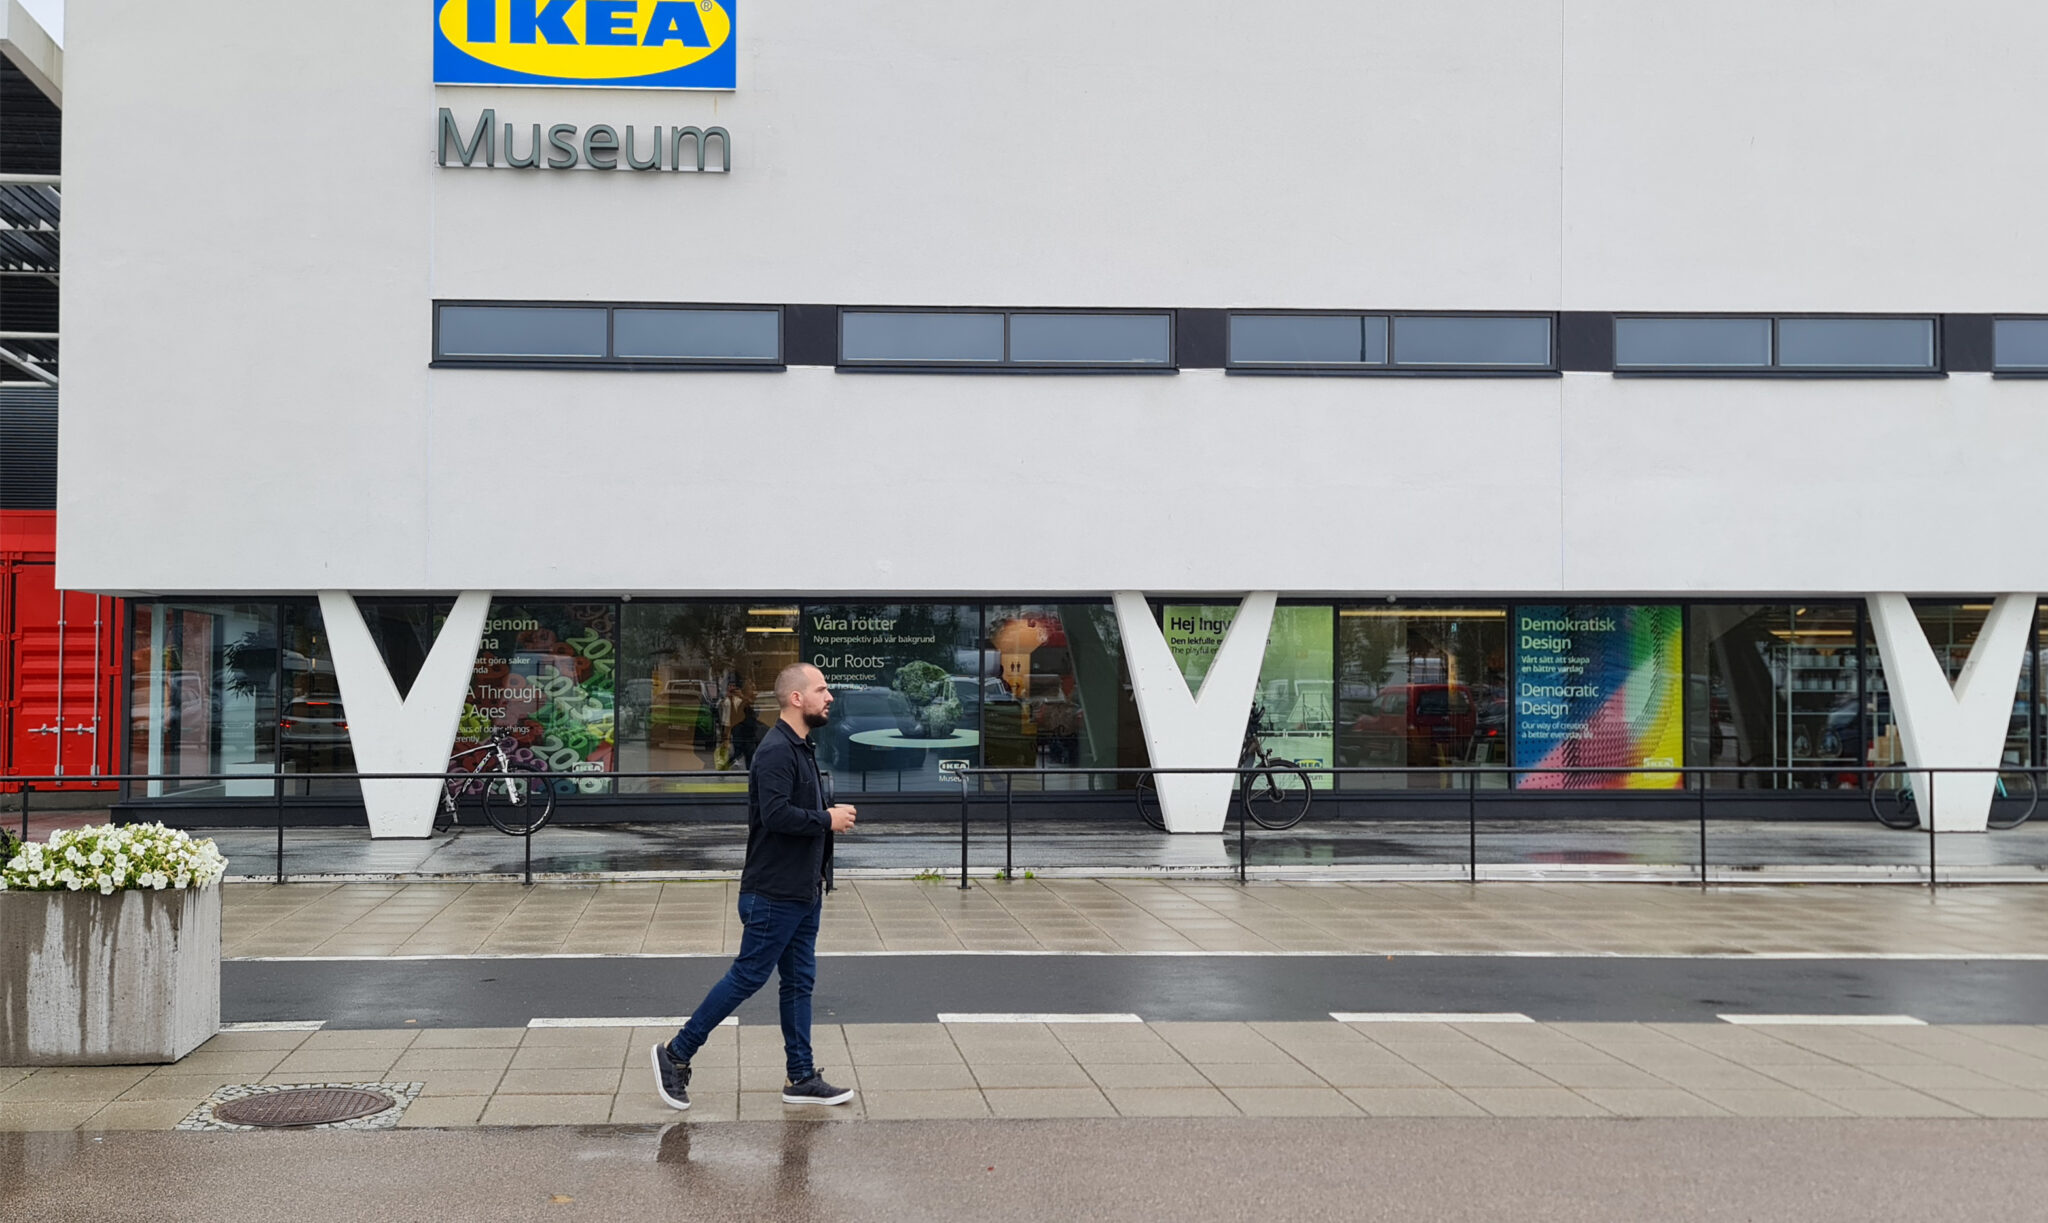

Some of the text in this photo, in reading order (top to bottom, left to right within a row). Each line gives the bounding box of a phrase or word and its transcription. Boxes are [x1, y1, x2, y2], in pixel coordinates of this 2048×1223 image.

[466, 0, 711, 47] IKEA
[438, 107, 730, 172] Museum
[483, 619, 539, 634] genom
[813, 614, 897, 631] Våra rötter
[1171, 616, 1232, 635] Hej Ingv
[1521, 617, 1616, 631] Demokratisk
[813, 635, 936, 645] Nya perspektiv på vår bakgrund
[1170, 637, 1186, 645] Den
[1187, 637, 1216, 645] lekfulle
[1521, 635, 1572, 653] Design
[1171, 646, 1184, 654] The
[1185, 646, 1209, 656] playful
[488, 657, 507, 666] göra
[508, 656, 531, 665] saker
[813, 654, 885, 668] Our Roots
[1521, 655, 1590, 665] Vårt sätt att skapa
[1533, 664, 1556, 673] bättre
[1558, 665, 1584, 674] vardag
[831, 673, 876, 682] perspectives
[478, 685, 542, 703] Through
[1521, 683, 1600, 697] Democratic
[469, 704, 506, 722] Ages
[1521, 701, 1569, 719] Design
[1536, 722, 1551, 730] way
[1552, 721, 1560, 729] of
[1560, 722, 1589, 731] creating
[455, 735, 480, 744] erently
[1550, 731, 1582, 740] everyday
